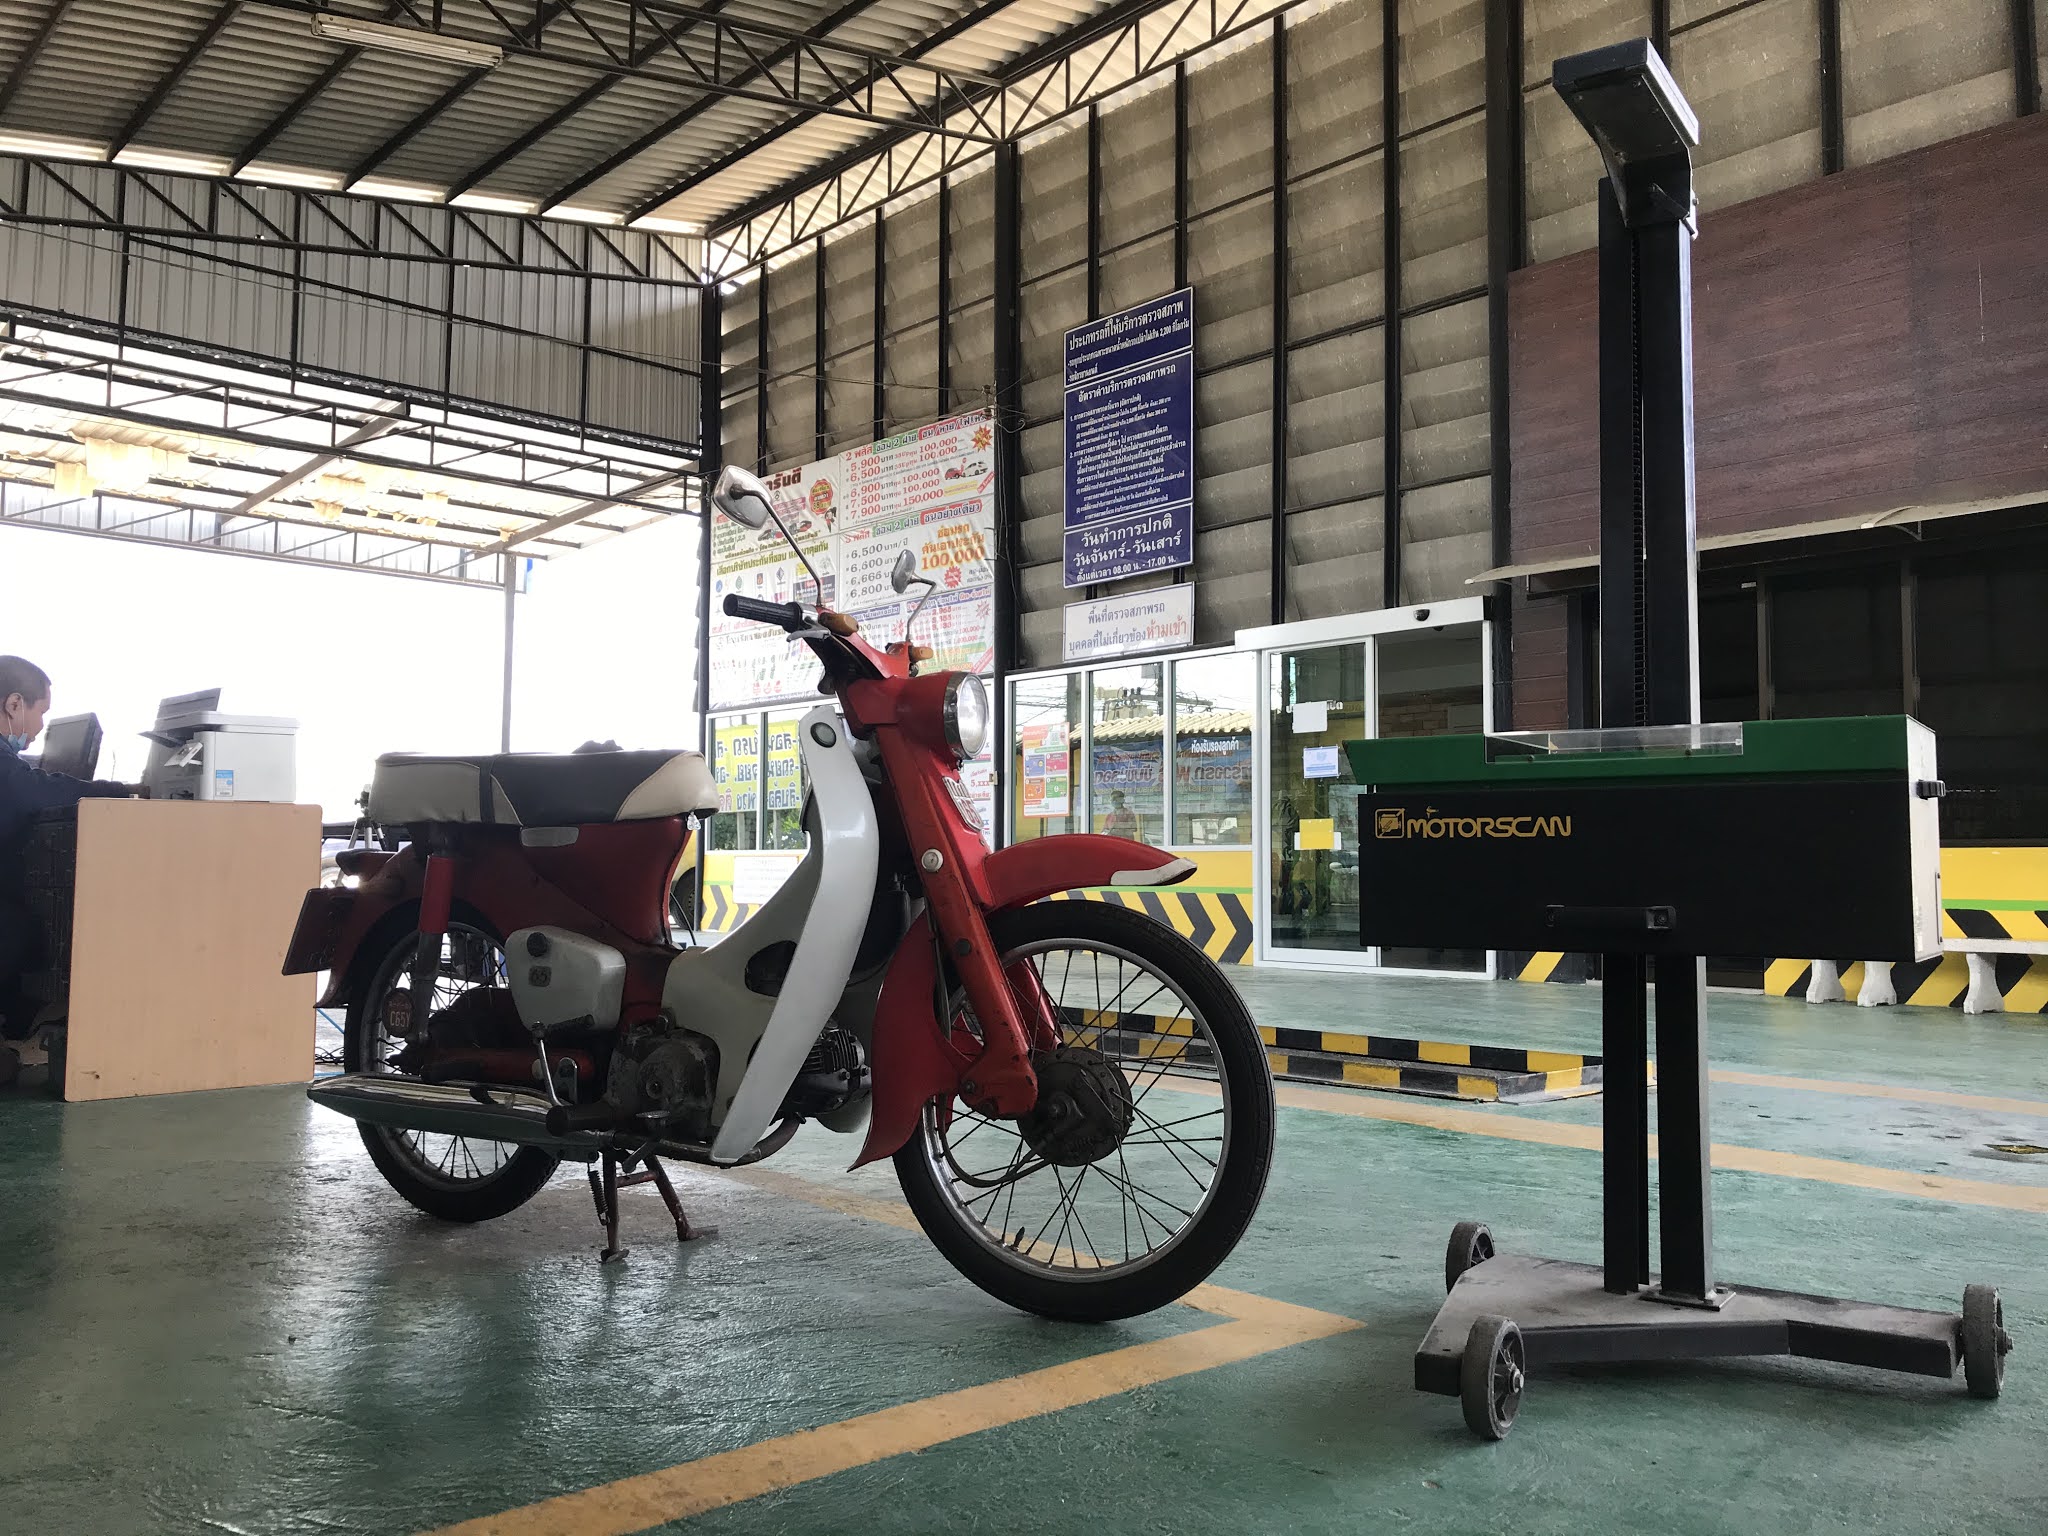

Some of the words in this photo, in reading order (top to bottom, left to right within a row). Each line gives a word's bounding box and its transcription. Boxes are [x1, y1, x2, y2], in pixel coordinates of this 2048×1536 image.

[1069, 300, 1184, 351] ประเภทรถที่ให้บริการตรวจสภาพ
[1079, 364, 1176, 403] อัตราค่าบริการตรวจสภาพรถ
[846, 452, 852, 461] 2
[893, 438, 899, 447] 2
[850, 455, 880, 472] 5,900
[881, 452, 894, 463] บาท
[919, 436, 957, 453] 100,000
[850, 466, 880, 483] 6,500
[881, 465, 894, 474] บาท
[919, 445, 957, 461] 100,000
[765, 467, 802, 491] ารันตี
[850, 482, 880, 499] 6,900
[902, 468, 940, 484] 100,000
[850, 493, 880, 509] 7,500
[903, 479, 940, 494] 100,000
[850, 504, 880, 520] 7,900
[903, 488, 944, 507] 150,000
[894, 521, 899, 530] 2
[924, 502, 980, 522] ชนอย่างเดียว
[1081, 513, 1172, 548] วันทำการปกติ
[851, 543, 883, 559] 6,500
[922, 545, 986, 571] 100,000
[1076, 567, 1112, 582] ตั้งแต่เวลา
[1113, 563, 1132, 575] 08.00
[1147, 557, 1166, 567] 17.00
[1167, 555, 1176, 564] น.
[850, 583, 882, 599] 6,800
[1088, 602, 1165, 624] พื้นที่ตรวจสภาพรถ
[1191, 736, 1239, 756] ห้องรับรองลูกค้า
[1407, 815, 1572, 839] MOTORSCAN
